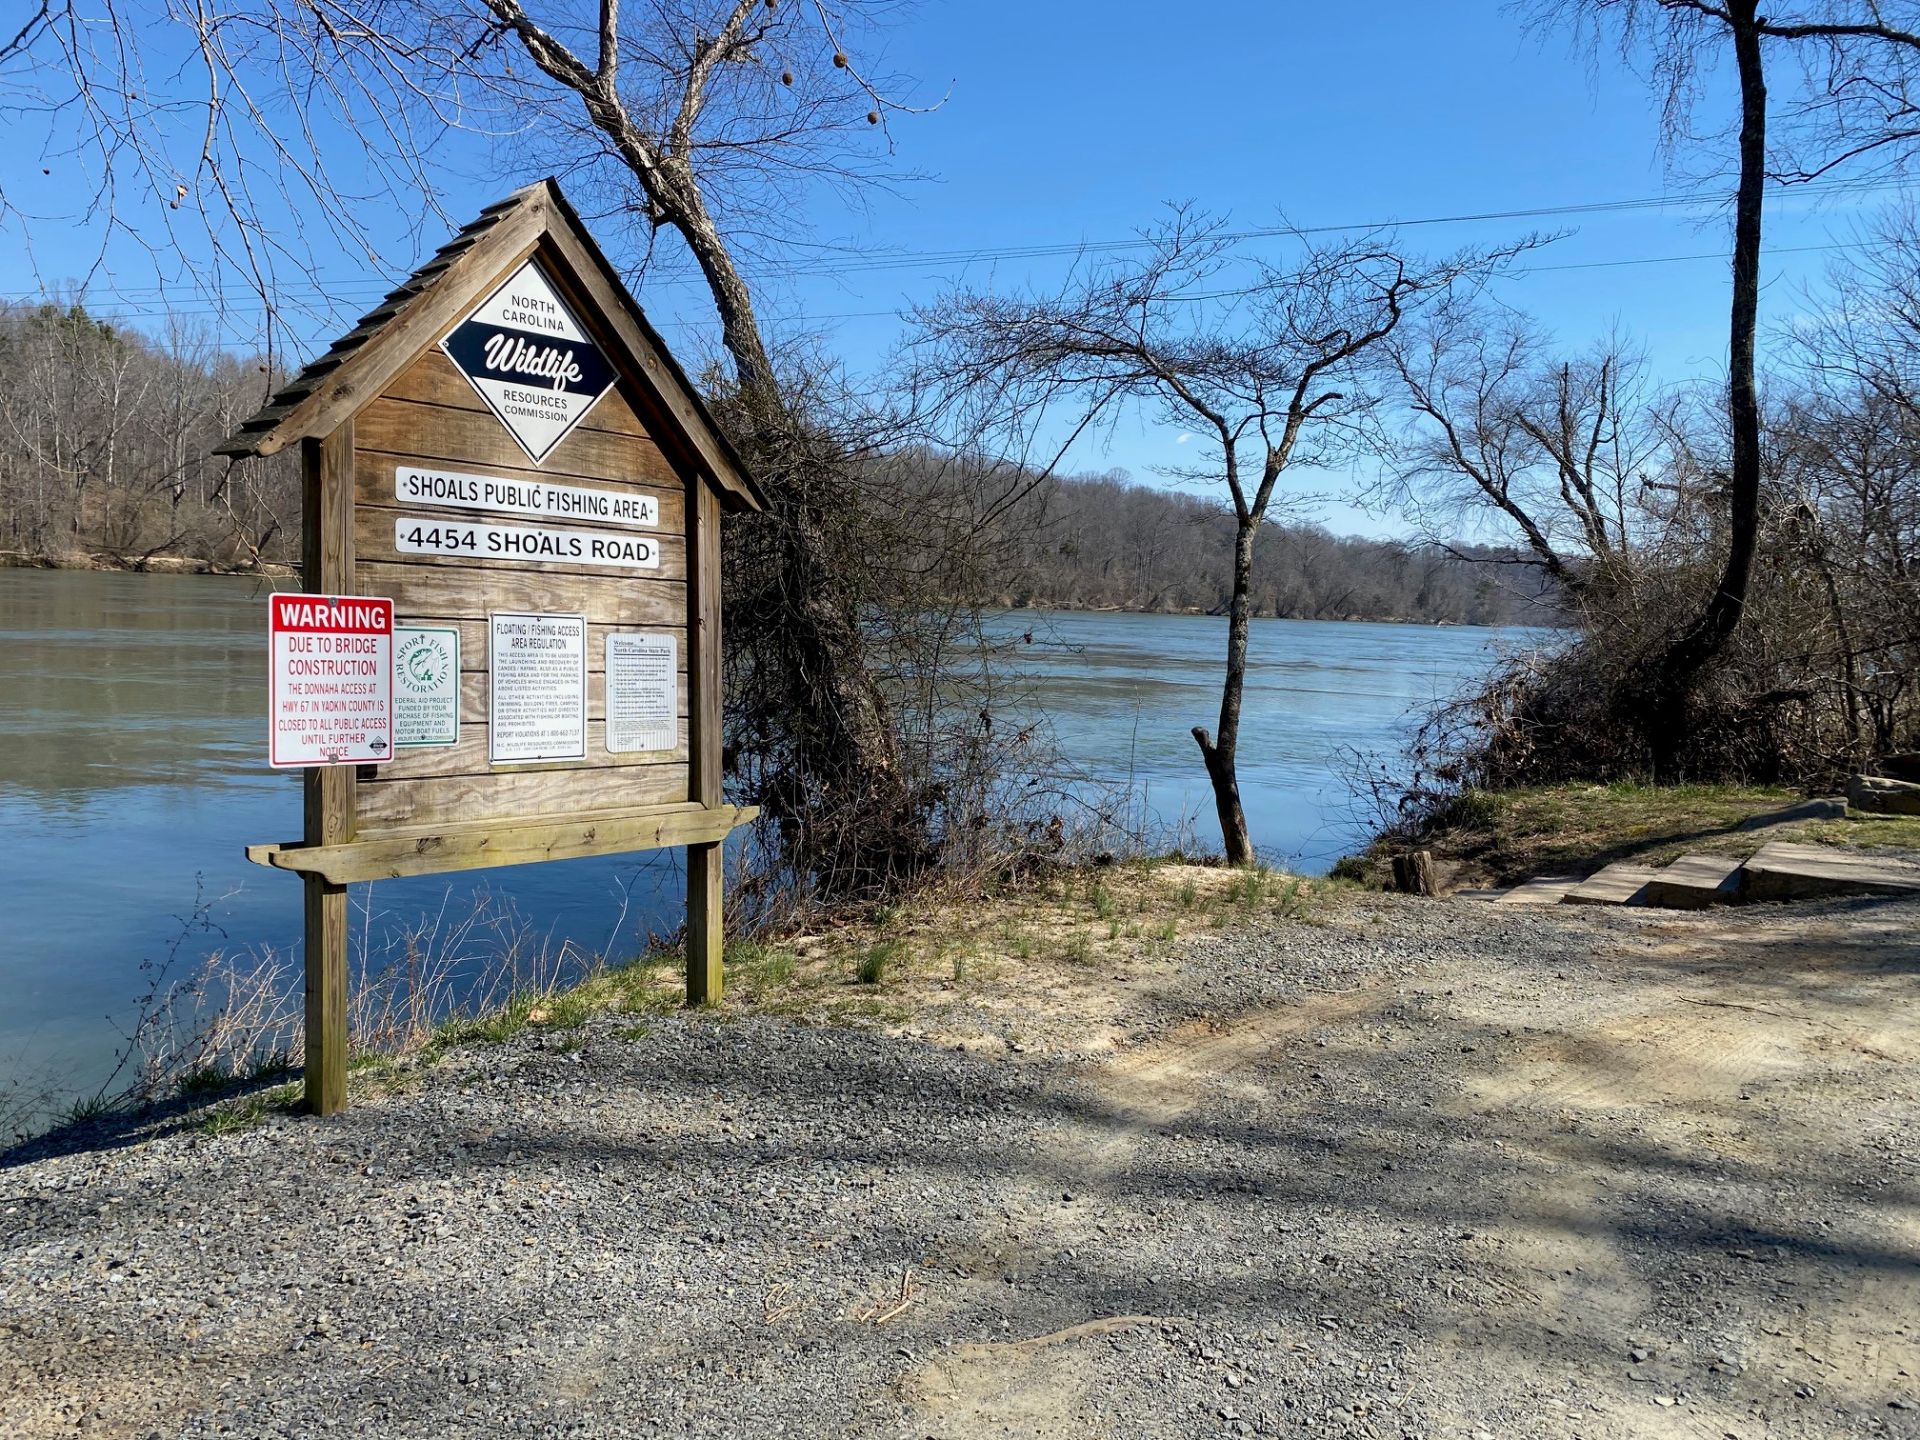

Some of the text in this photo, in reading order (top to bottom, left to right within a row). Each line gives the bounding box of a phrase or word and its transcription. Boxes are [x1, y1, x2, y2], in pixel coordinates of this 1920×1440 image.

[511, 295, 555, 314] NORTH
[502, 309, 564, 332] CAROLINA
[484, 333, 583, 392] Wildlife
[503, 389, 568, 410] RESOURCES
[504, 405, 568, 422] COMMISSION
[408, 474, 649, 521] SHOALS PUBLIC FISHING AREA
[407, 527, 651, 561] 4454 SHOALS ROAD
[280, 603, 386, 630] WARNING
[496, 623, 527, 635] FLOATING
[531, 624, 556, 636] FISHING
[557, 625, 580, 637] ACCESS
[289, 636, 377, 654] DUE TO BRIDGE
[396, 636, 448, 660] SPORT FISH
[511, 637, 567, 649] AREA REGULATION
[288, 659, 377, 676] CONSTRUCTION
[396, 663, 448, 693] RESTORATION
[288, 683, 377, 695] THE DONNAHA ACCESS AT
[282, 700, 384, 713] HWY 67 IN YADKIN COUNTY IS
[278, 718, 387, 731] CLOSED TO ALL PUBLIC ACCESS
[301, 733, 366, 745] UNTIL FURTHER
[319, 746, 349, 757] NOTICE
